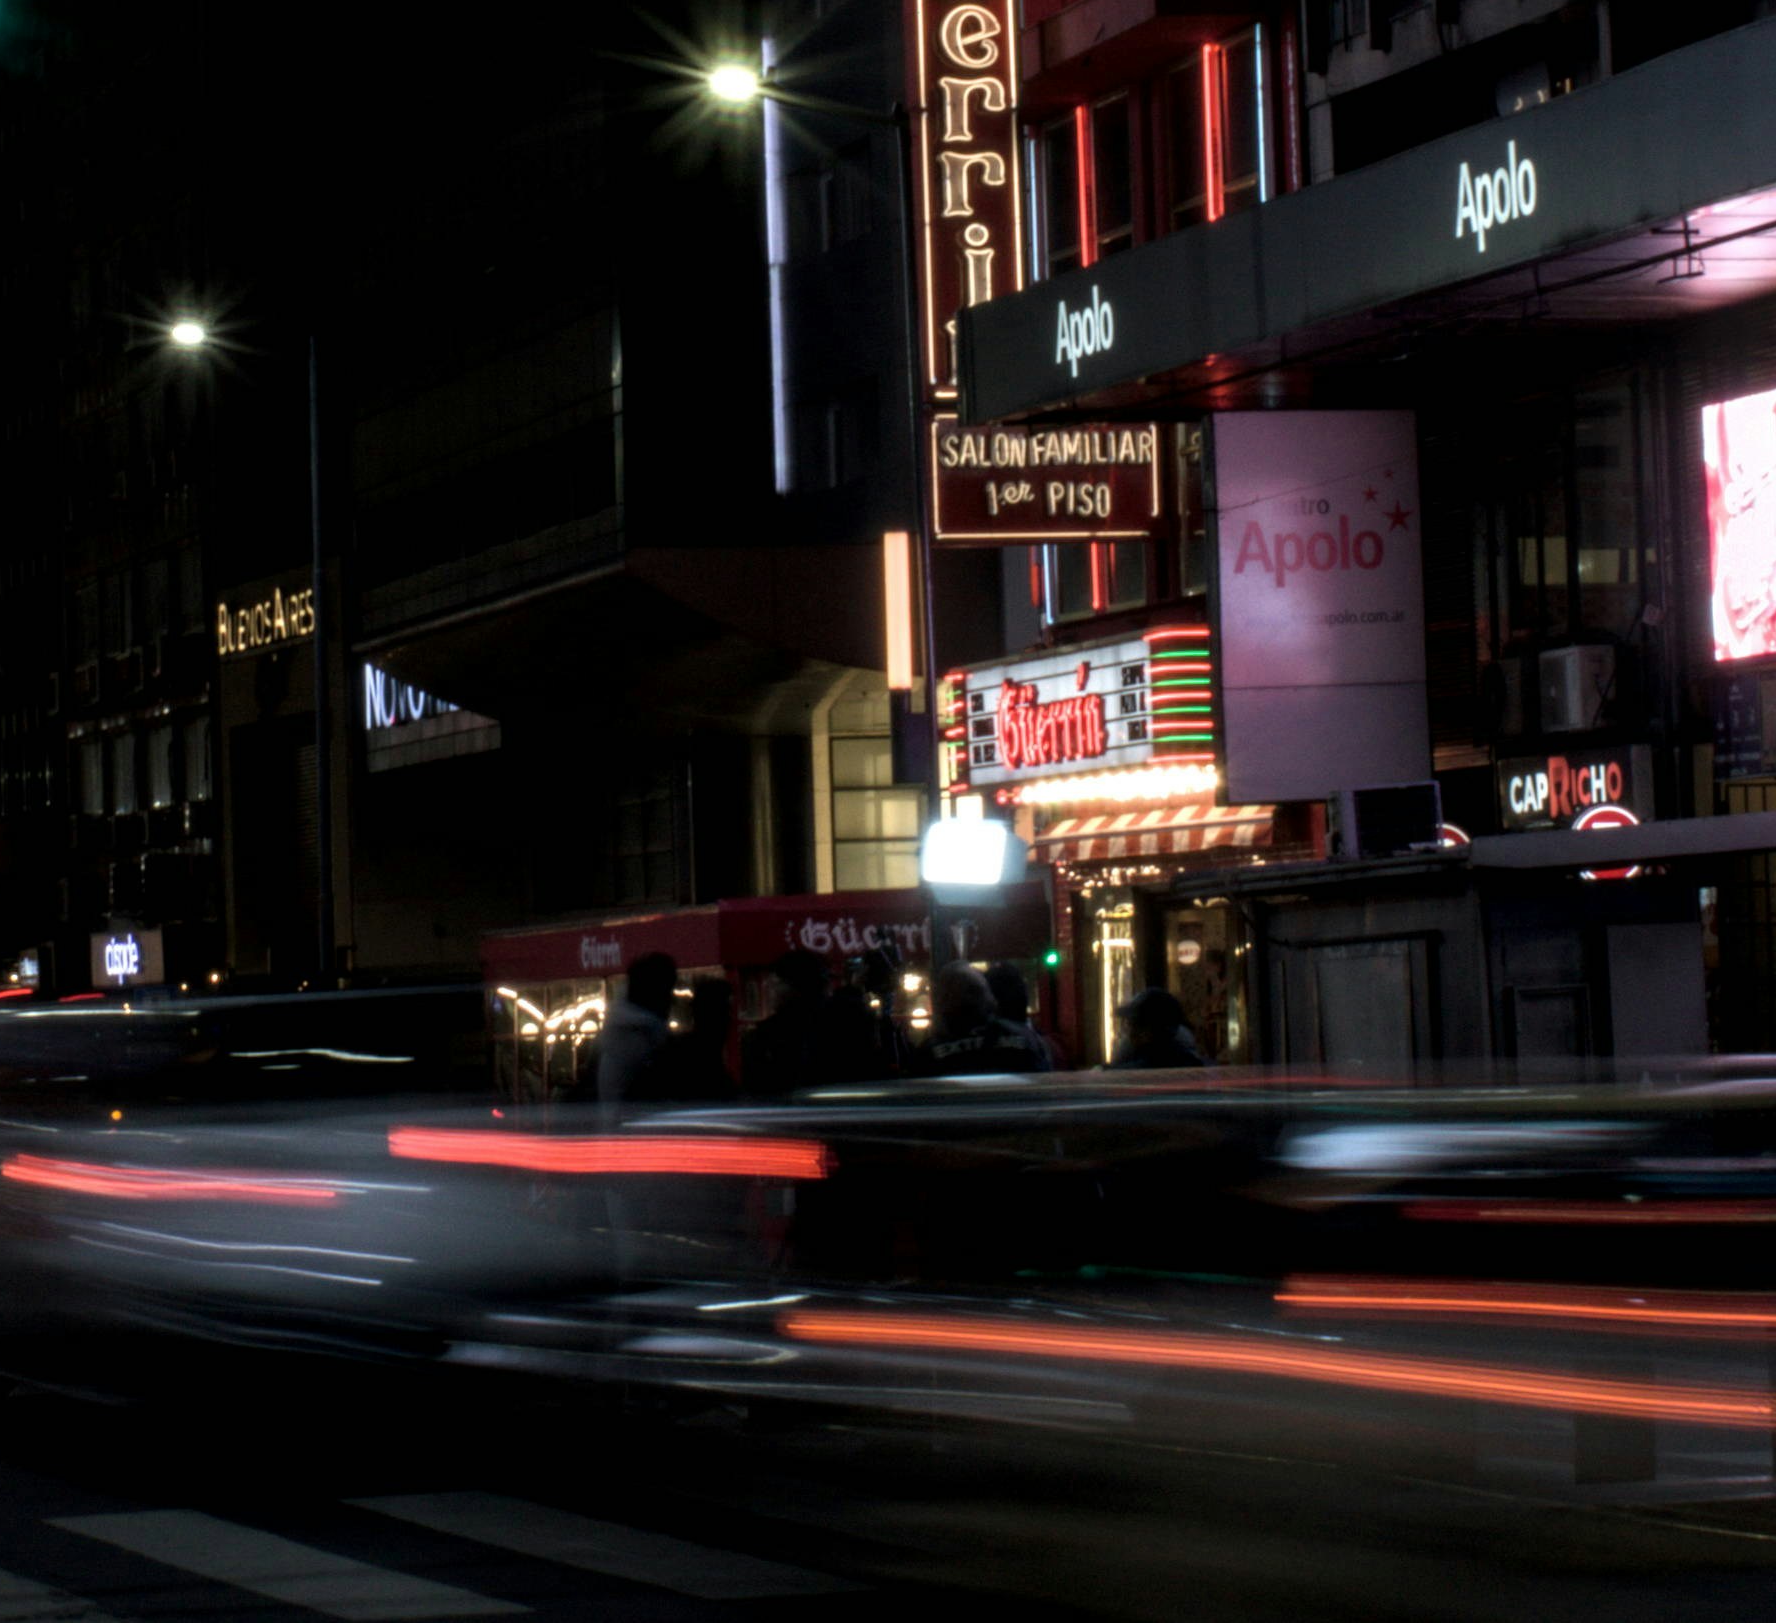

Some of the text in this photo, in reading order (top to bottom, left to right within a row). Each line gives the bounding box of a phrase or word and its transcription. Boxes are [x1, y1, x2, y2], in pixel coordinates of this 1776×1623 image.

[1454, 139, 1538, 253] Apolo
[1055, 284, 1115, 378] Apolo
[942, 428, 1153, 468] SALON FAMILIAR
[1047, 480, 1112, 518] PISO
[1233, 514, 1384, 589] Apolo
[1509, 755, 1623, 819] CAPRICHO
